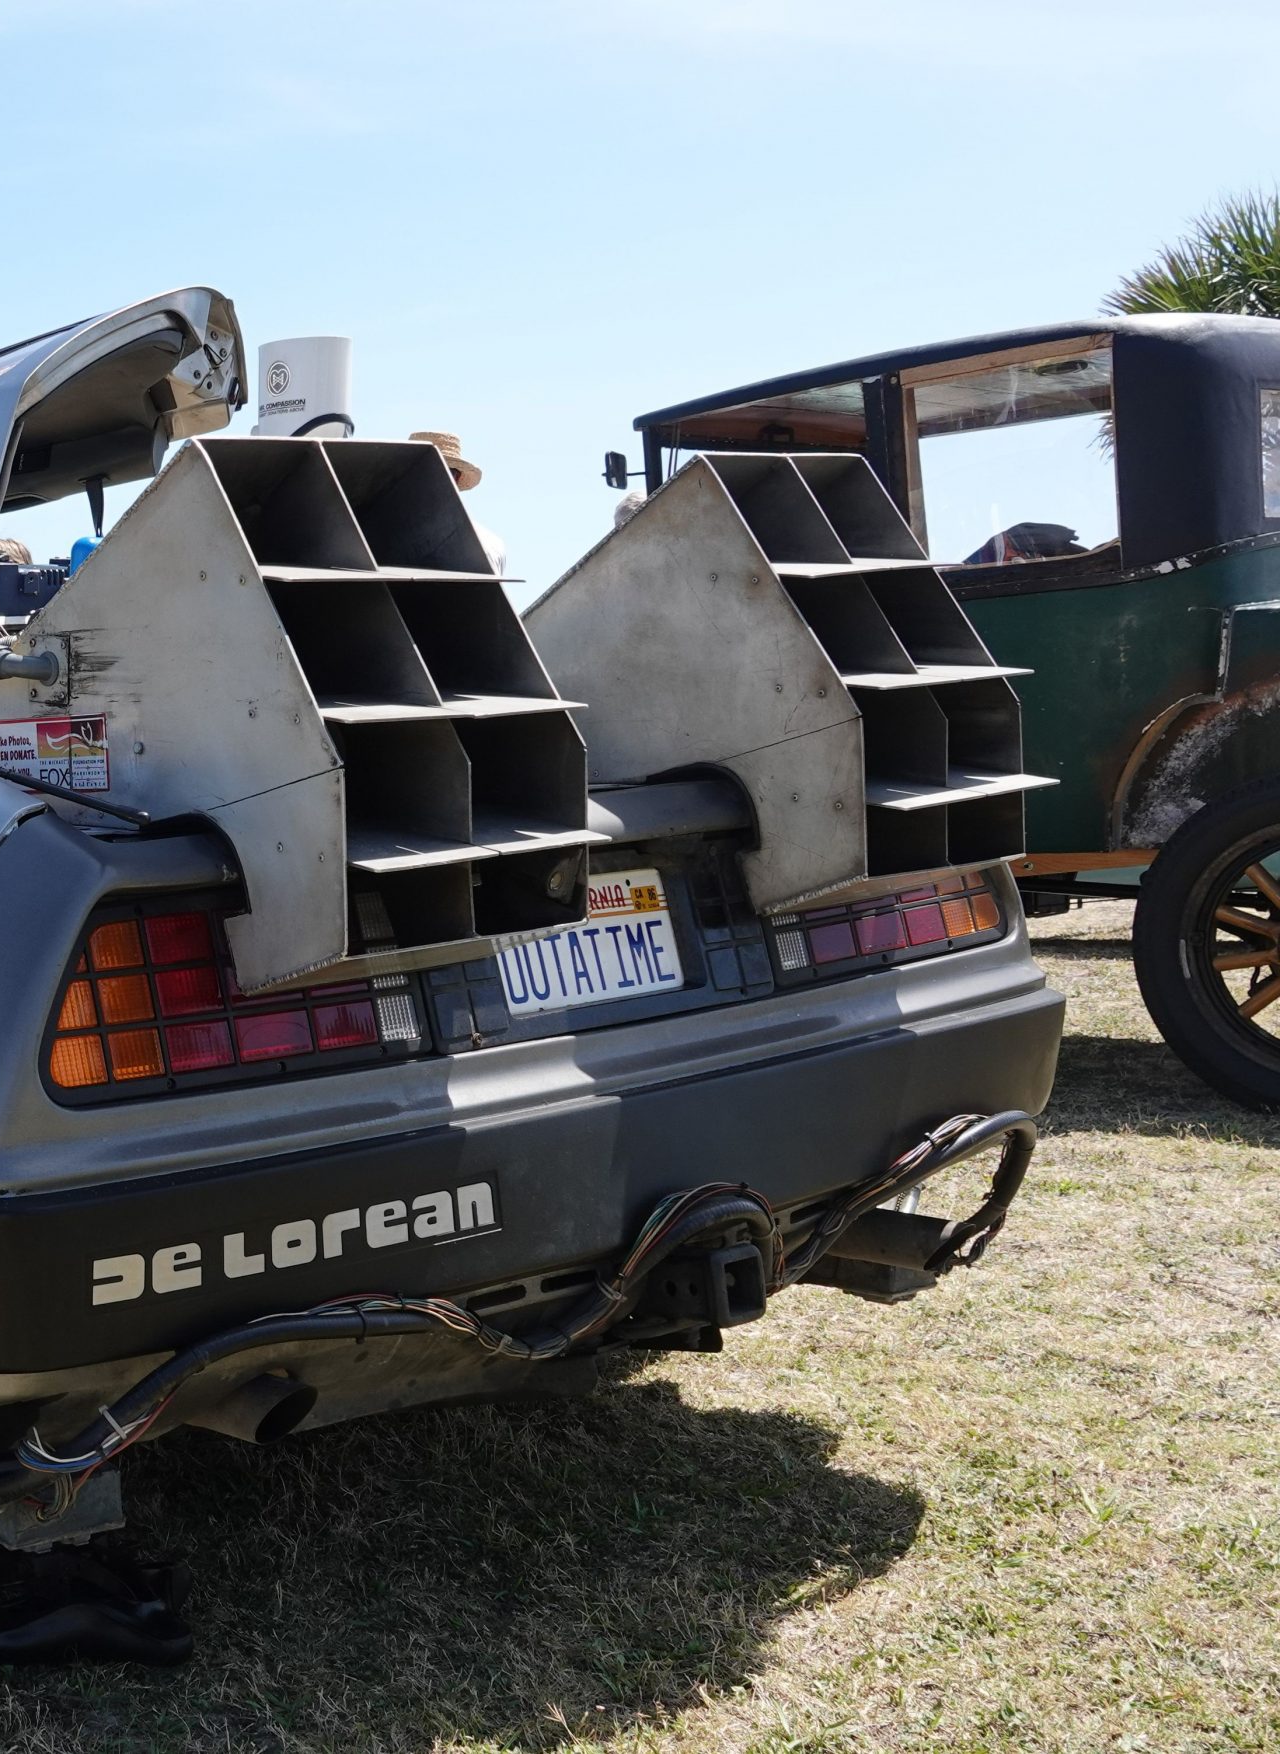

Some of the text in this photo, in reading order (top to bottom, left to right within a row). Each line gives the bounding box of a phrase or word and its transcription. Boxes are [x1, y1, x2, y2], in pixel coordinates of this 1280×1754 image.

[265, 399, 306, 410] COMPASSION
[40, 768, 70, 786] FOX
[635, 888, 644, 899] CA
[647, 887, 657, 900] 86
[500, 919, 676, 1005] OUTATIME
